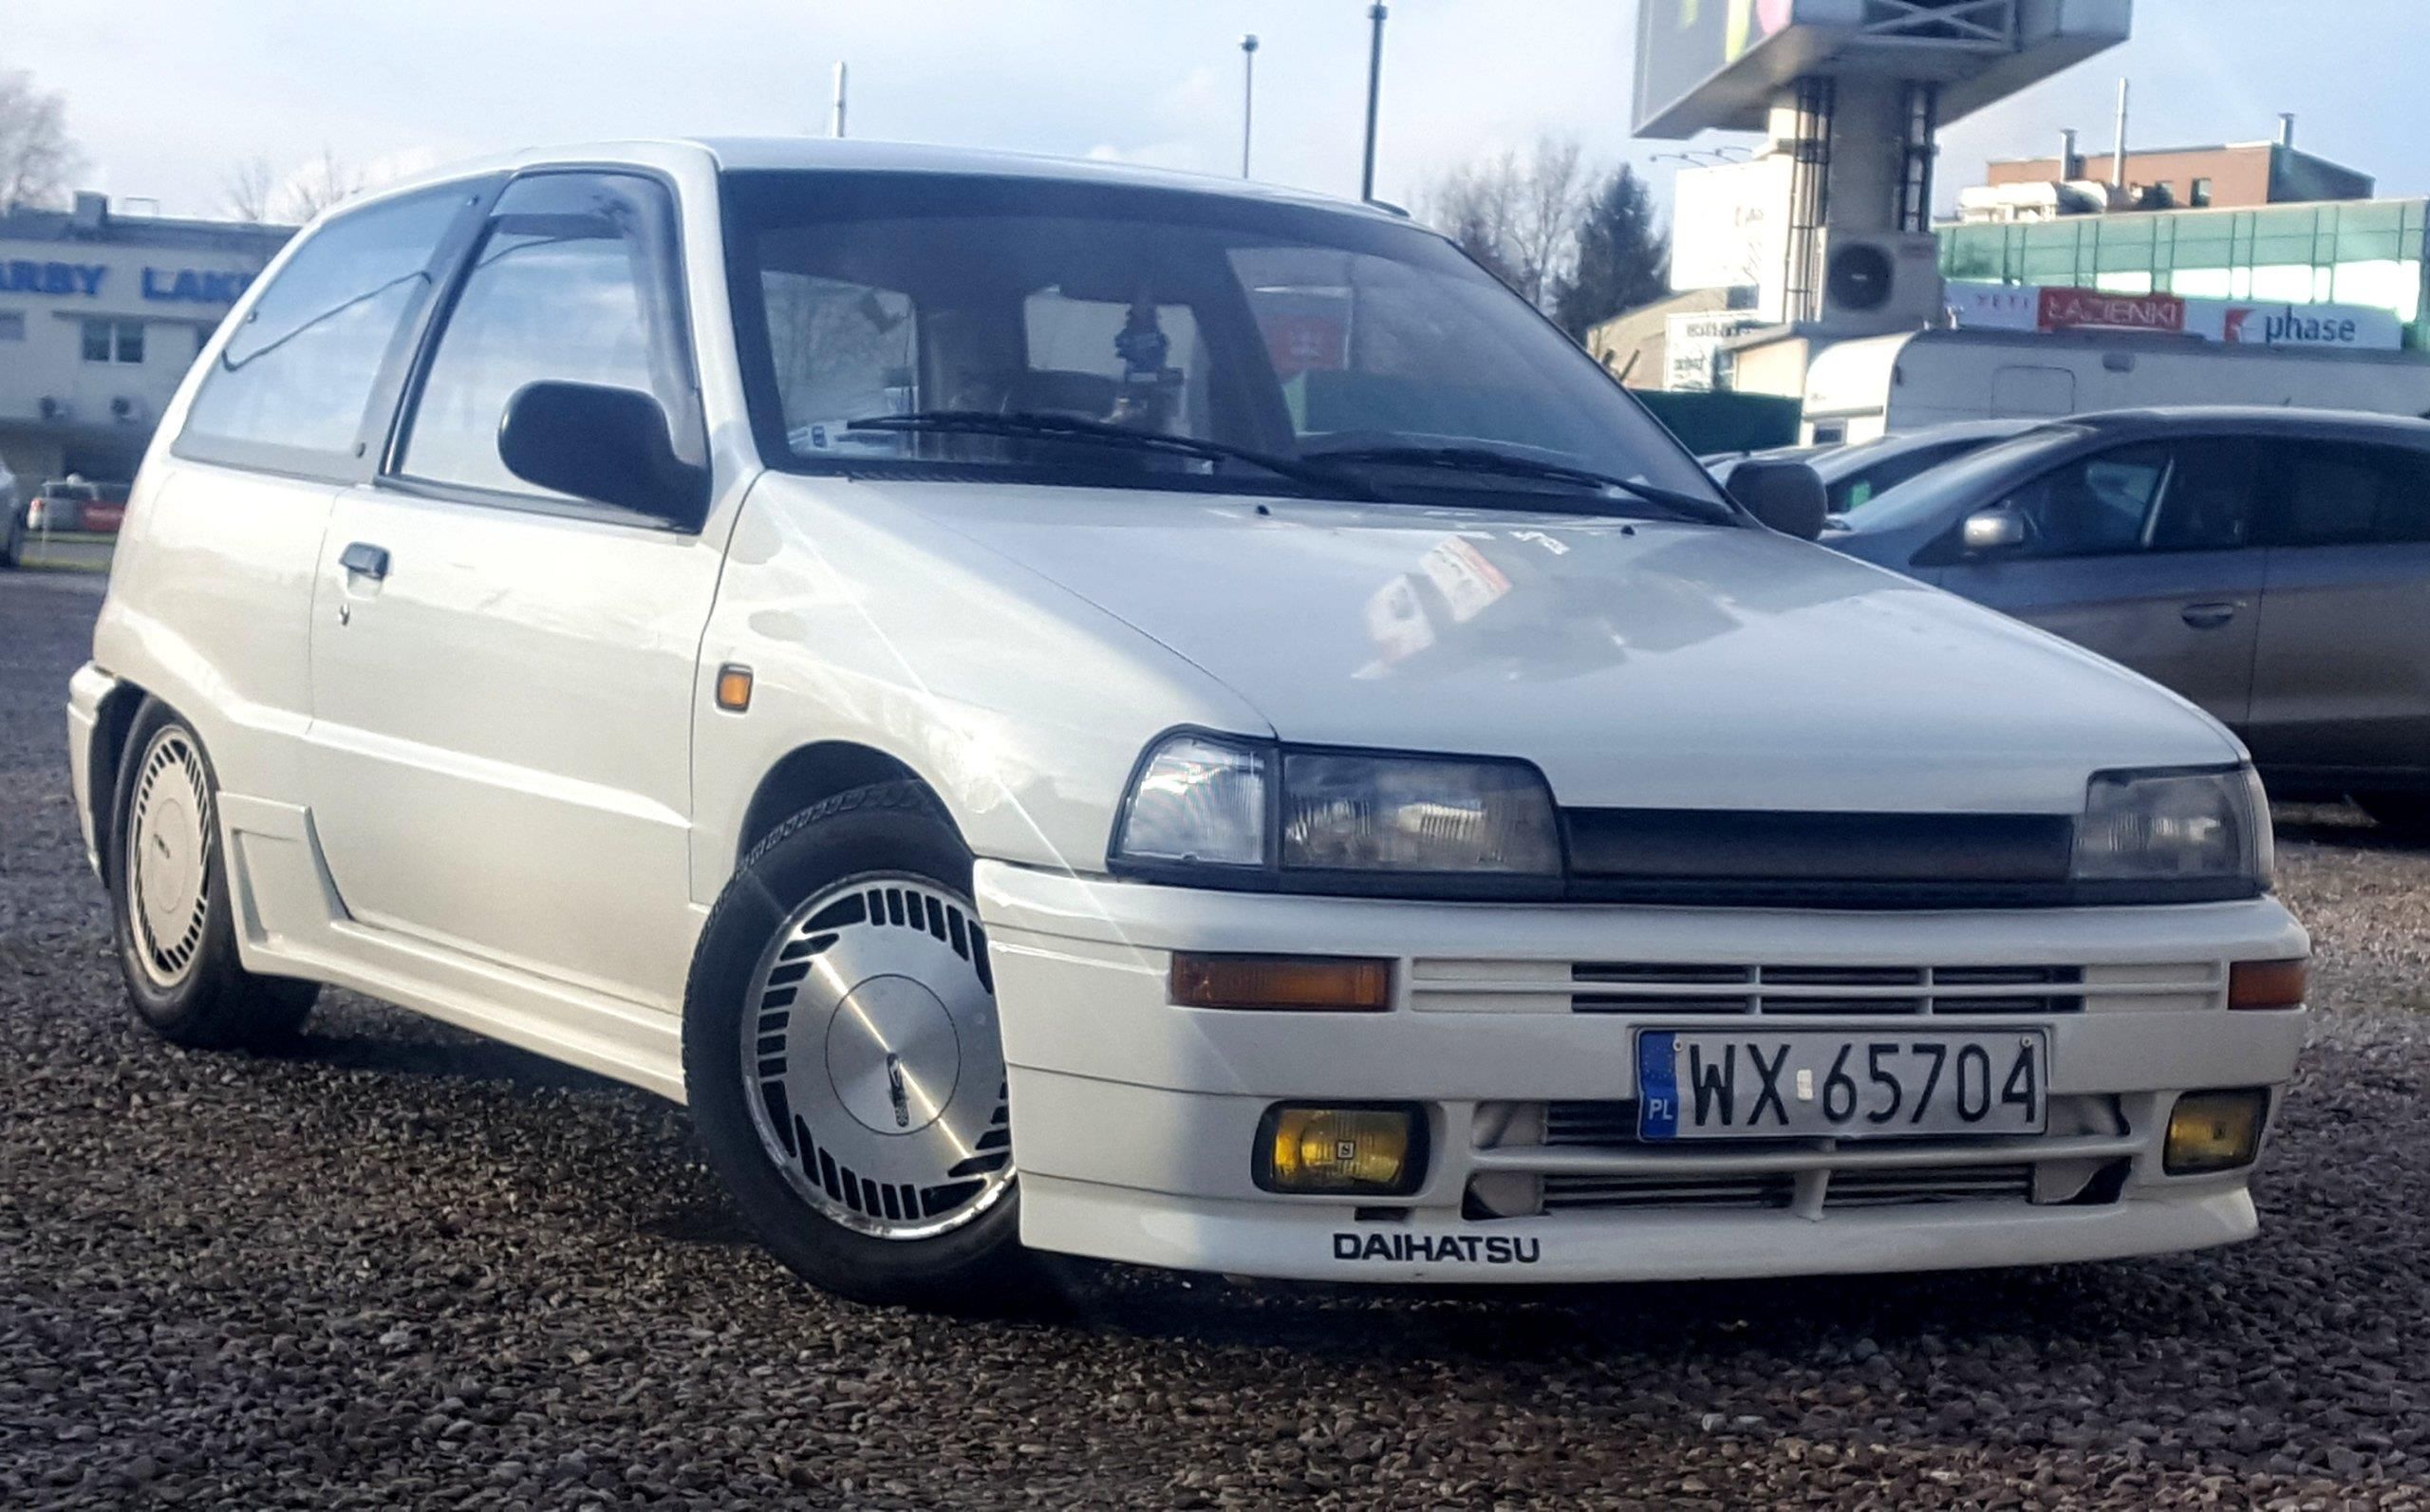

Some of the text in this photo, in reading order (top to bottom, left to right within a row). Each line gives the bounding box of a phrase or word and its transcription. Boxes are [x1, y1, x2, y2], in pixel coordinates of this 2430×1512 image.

[2265, 305, 2356, 344] phase
[1690, 1042, 2035, 1127] WX 65704
[1649, 1099, 1673, 1121] PL
[1333, 1233, 1541, 1264] DAIHATSU
